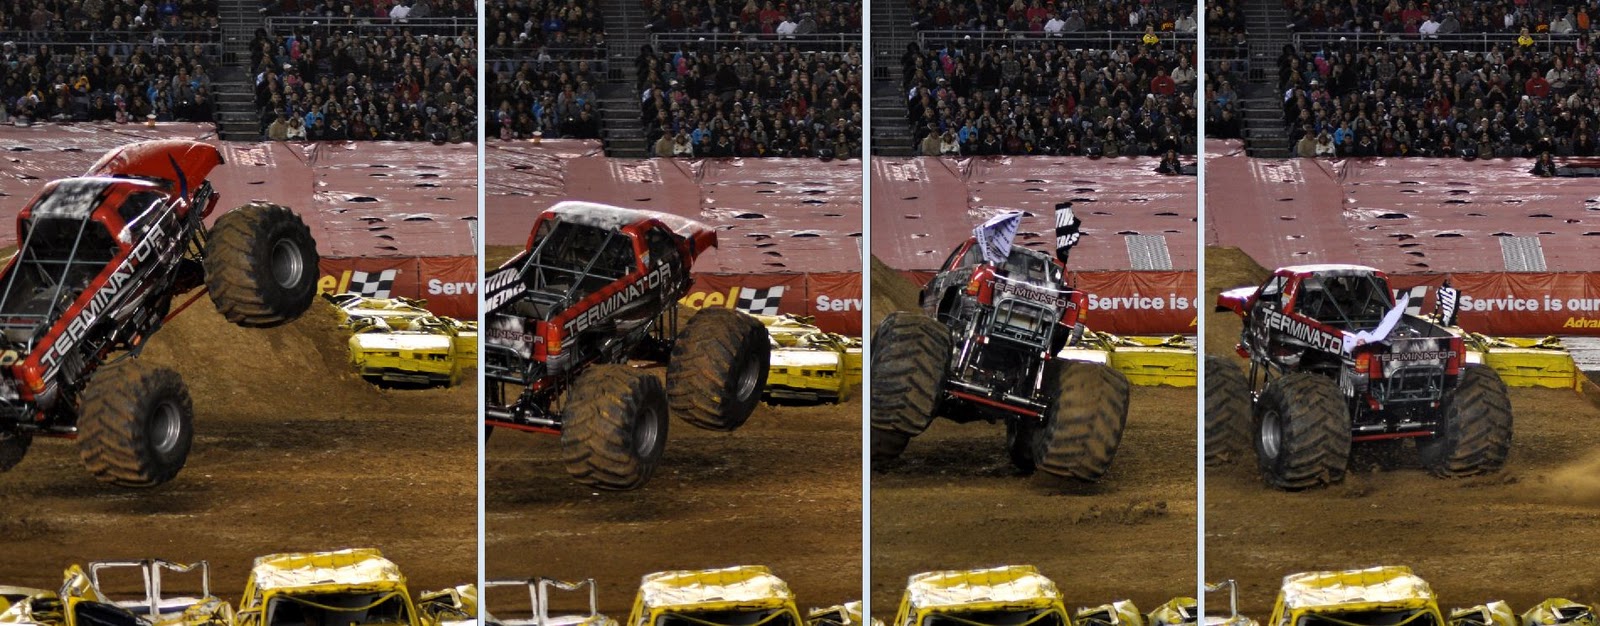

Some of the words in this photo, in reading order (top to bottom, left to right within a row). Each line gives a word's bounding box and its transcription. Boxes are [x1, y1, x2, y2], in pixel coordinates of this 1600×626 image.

[40, 224, 165, 367] TERMINATOR
[564, 262, 672, 338] TERMINATOR
[678, 286, 740, 310] cel
[986, 279, 1078, 310] TERMINATOR
[1088, 293, 1164, 310] Service
[1170, 293, 1189, 310] is
[1459, 294, 1539, 312] Service
[1544, 294, 1562, 312] is
[1262, 307, 1352, 360] TERMINATO
[1374, 350, 1457, 363] TERMINATOR
